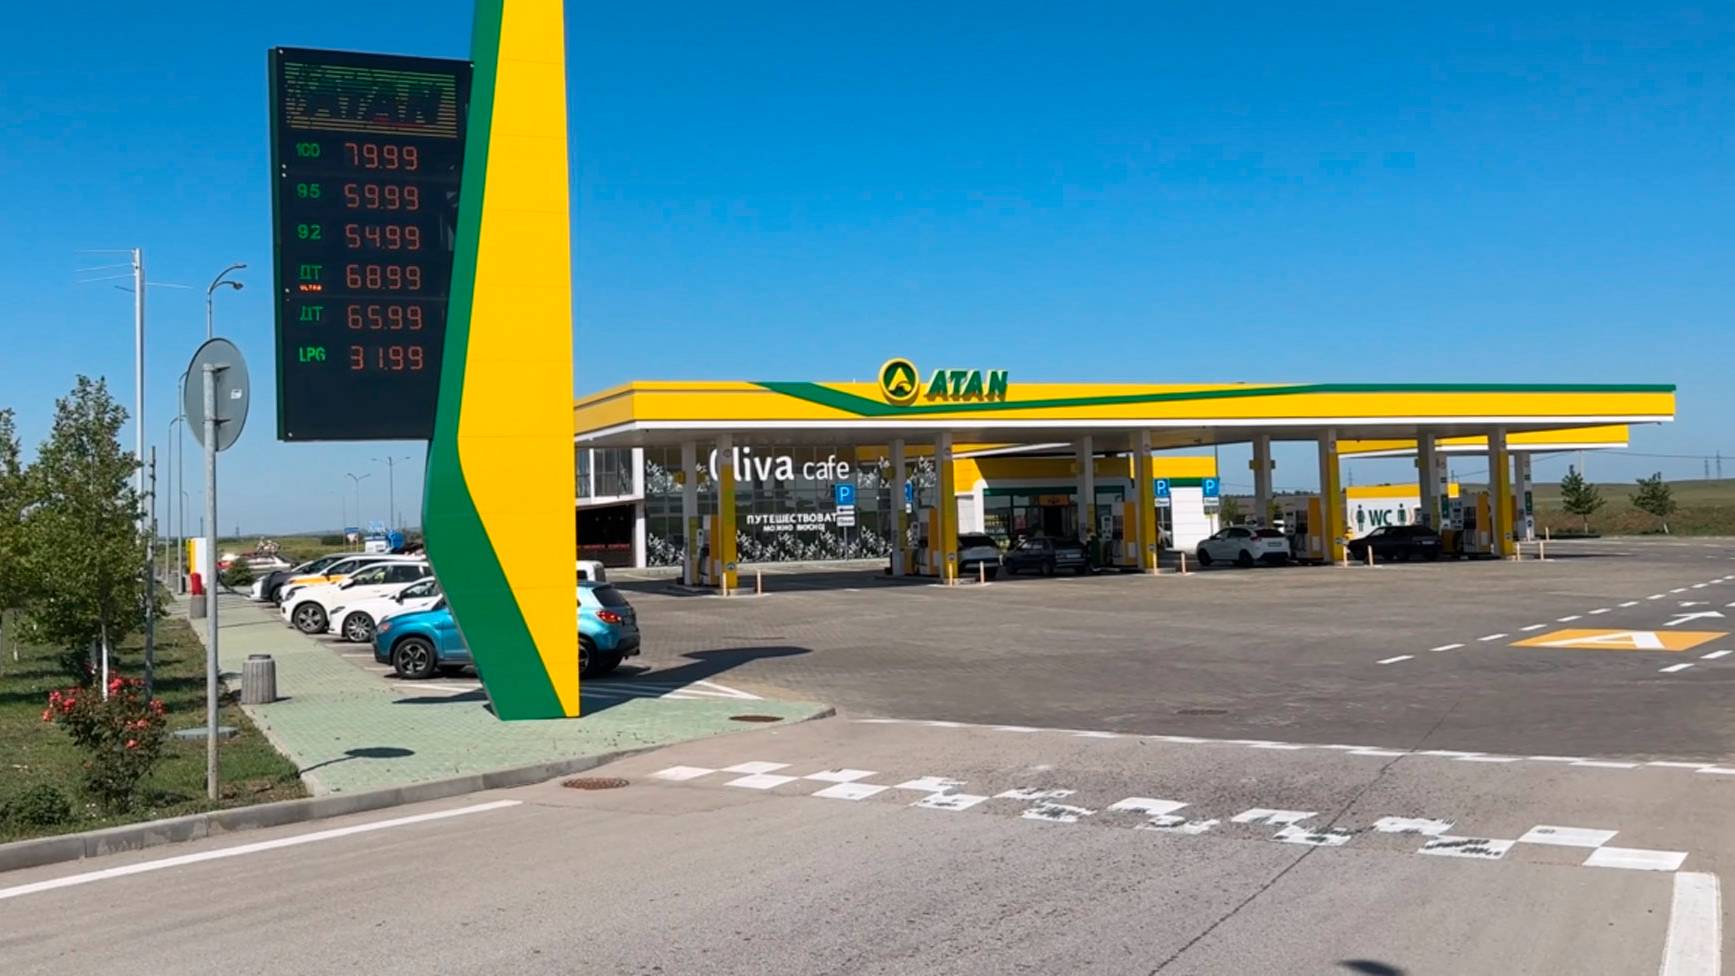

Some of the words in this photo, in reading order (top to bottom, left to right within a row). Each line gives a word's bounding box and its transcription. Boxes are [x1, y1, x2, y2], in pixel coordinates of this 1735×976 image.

[296, 143, 321, 158] 100
[345, 142, 419, 170] 79.99
[297, 183, 321, 198] 95
[344, 183, 420, 211] 59.99
[297, 224, 322, 239] 92
[345, 223, 421, 251] 54.99
[299, 264, 322, 280] ДТ
[346, 264, 421, 290] 68.99
[299, 305, 323, 321] ДТ
[347, 305, 422, 330] 65.99
[299, 347, 327, 363] LPG
[350, 345, 424, 371] 31.99
[926, 368, 1009, 400] ATAN
[803, 454, 850, 481] cafe
[840, 486, 850, 501] P
[746, 512, 838, 525] ПУТЕШЕСТВОВАТ
[1368, 509, 1393, 526] WC
